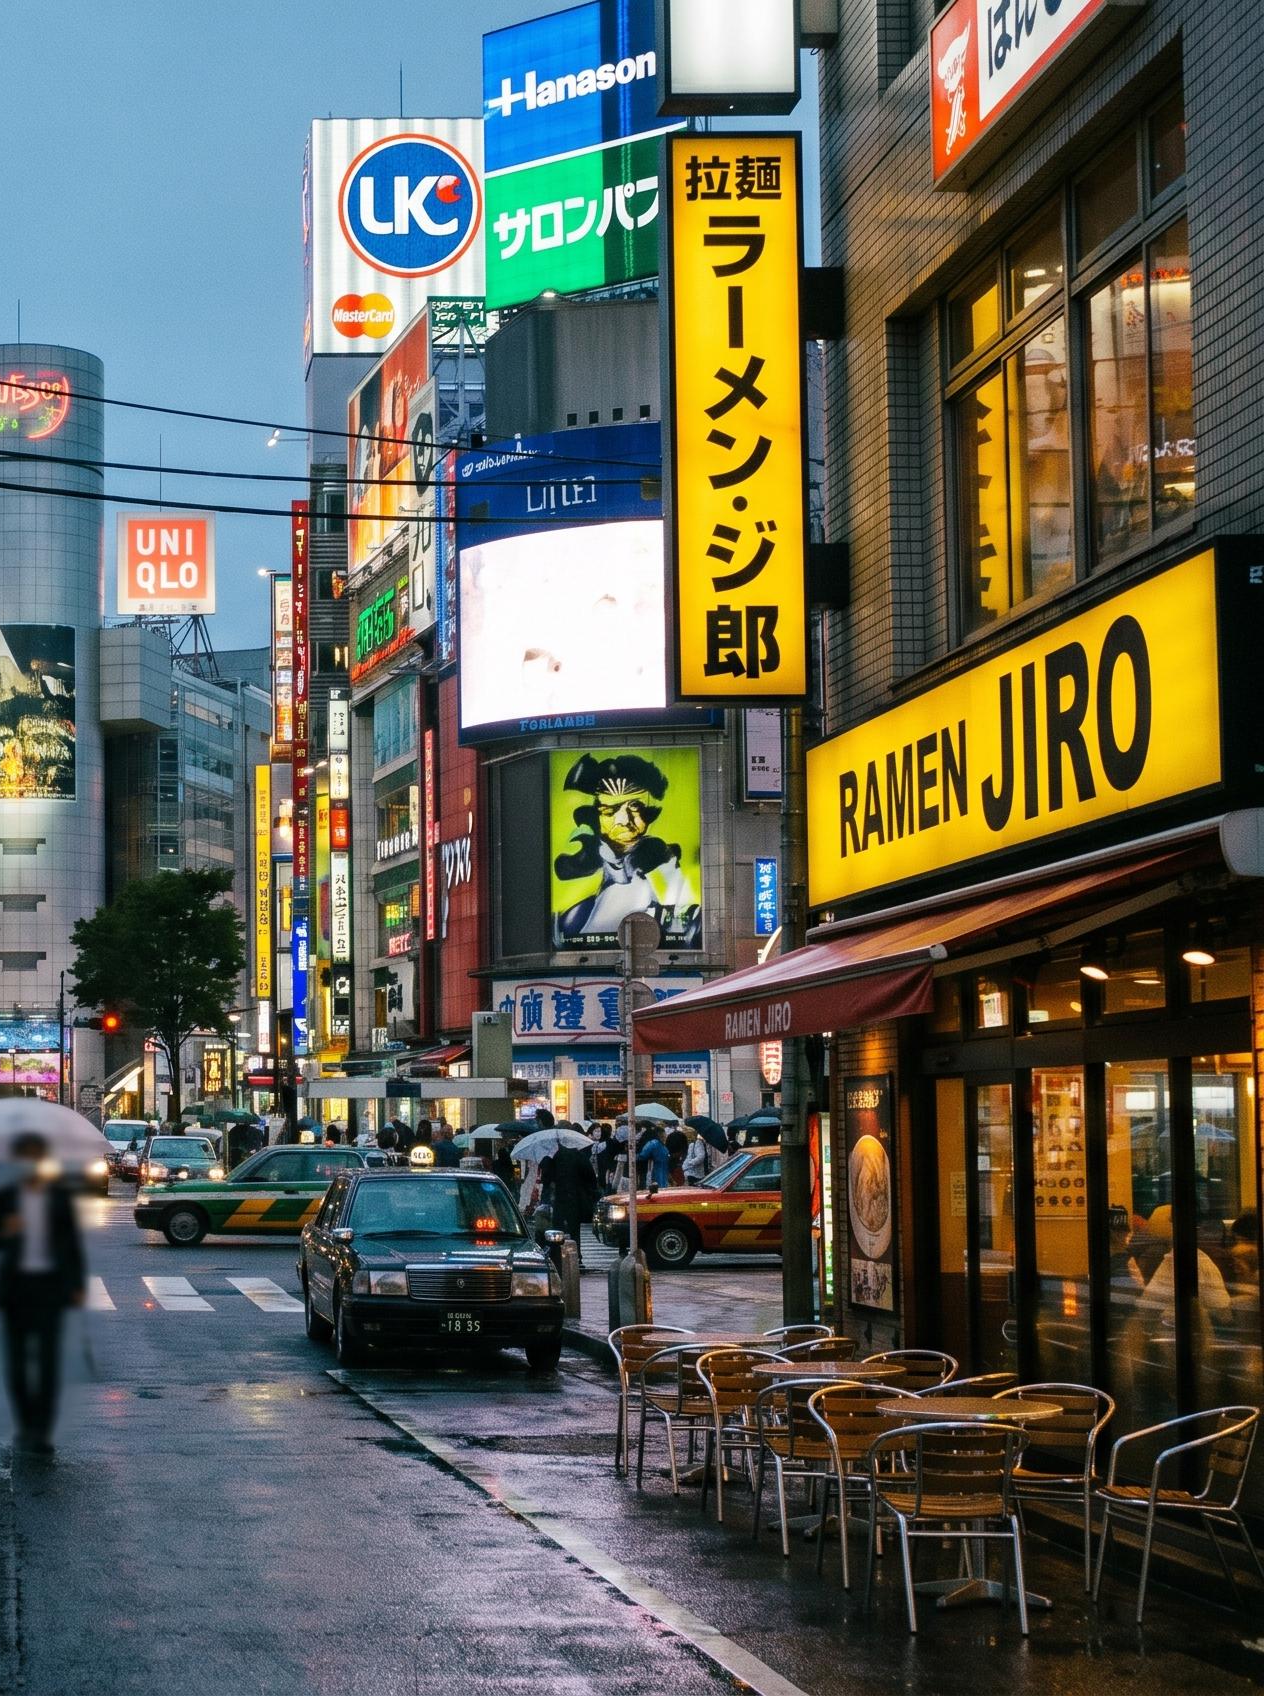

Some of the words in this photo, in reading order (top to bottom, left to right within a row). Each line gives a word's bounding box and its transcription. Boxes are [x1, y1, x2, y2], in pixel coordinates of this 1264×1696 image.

[686, 155, 782, 201] 拉麺
[334, 307, 394, 323] MasterCard
[703, 215, 781, 679] ラーメン・ジ郎
[136, 528, 194, 556] UNI
[136, 561, 199, 594] QLO
[839, 719, 969, 859] RAMEN
[981, 614, 1152, 832] JIRO
[726, 1008, 760, 1040] RAMEN
[765, 1001, 791, 1034] JIRO
